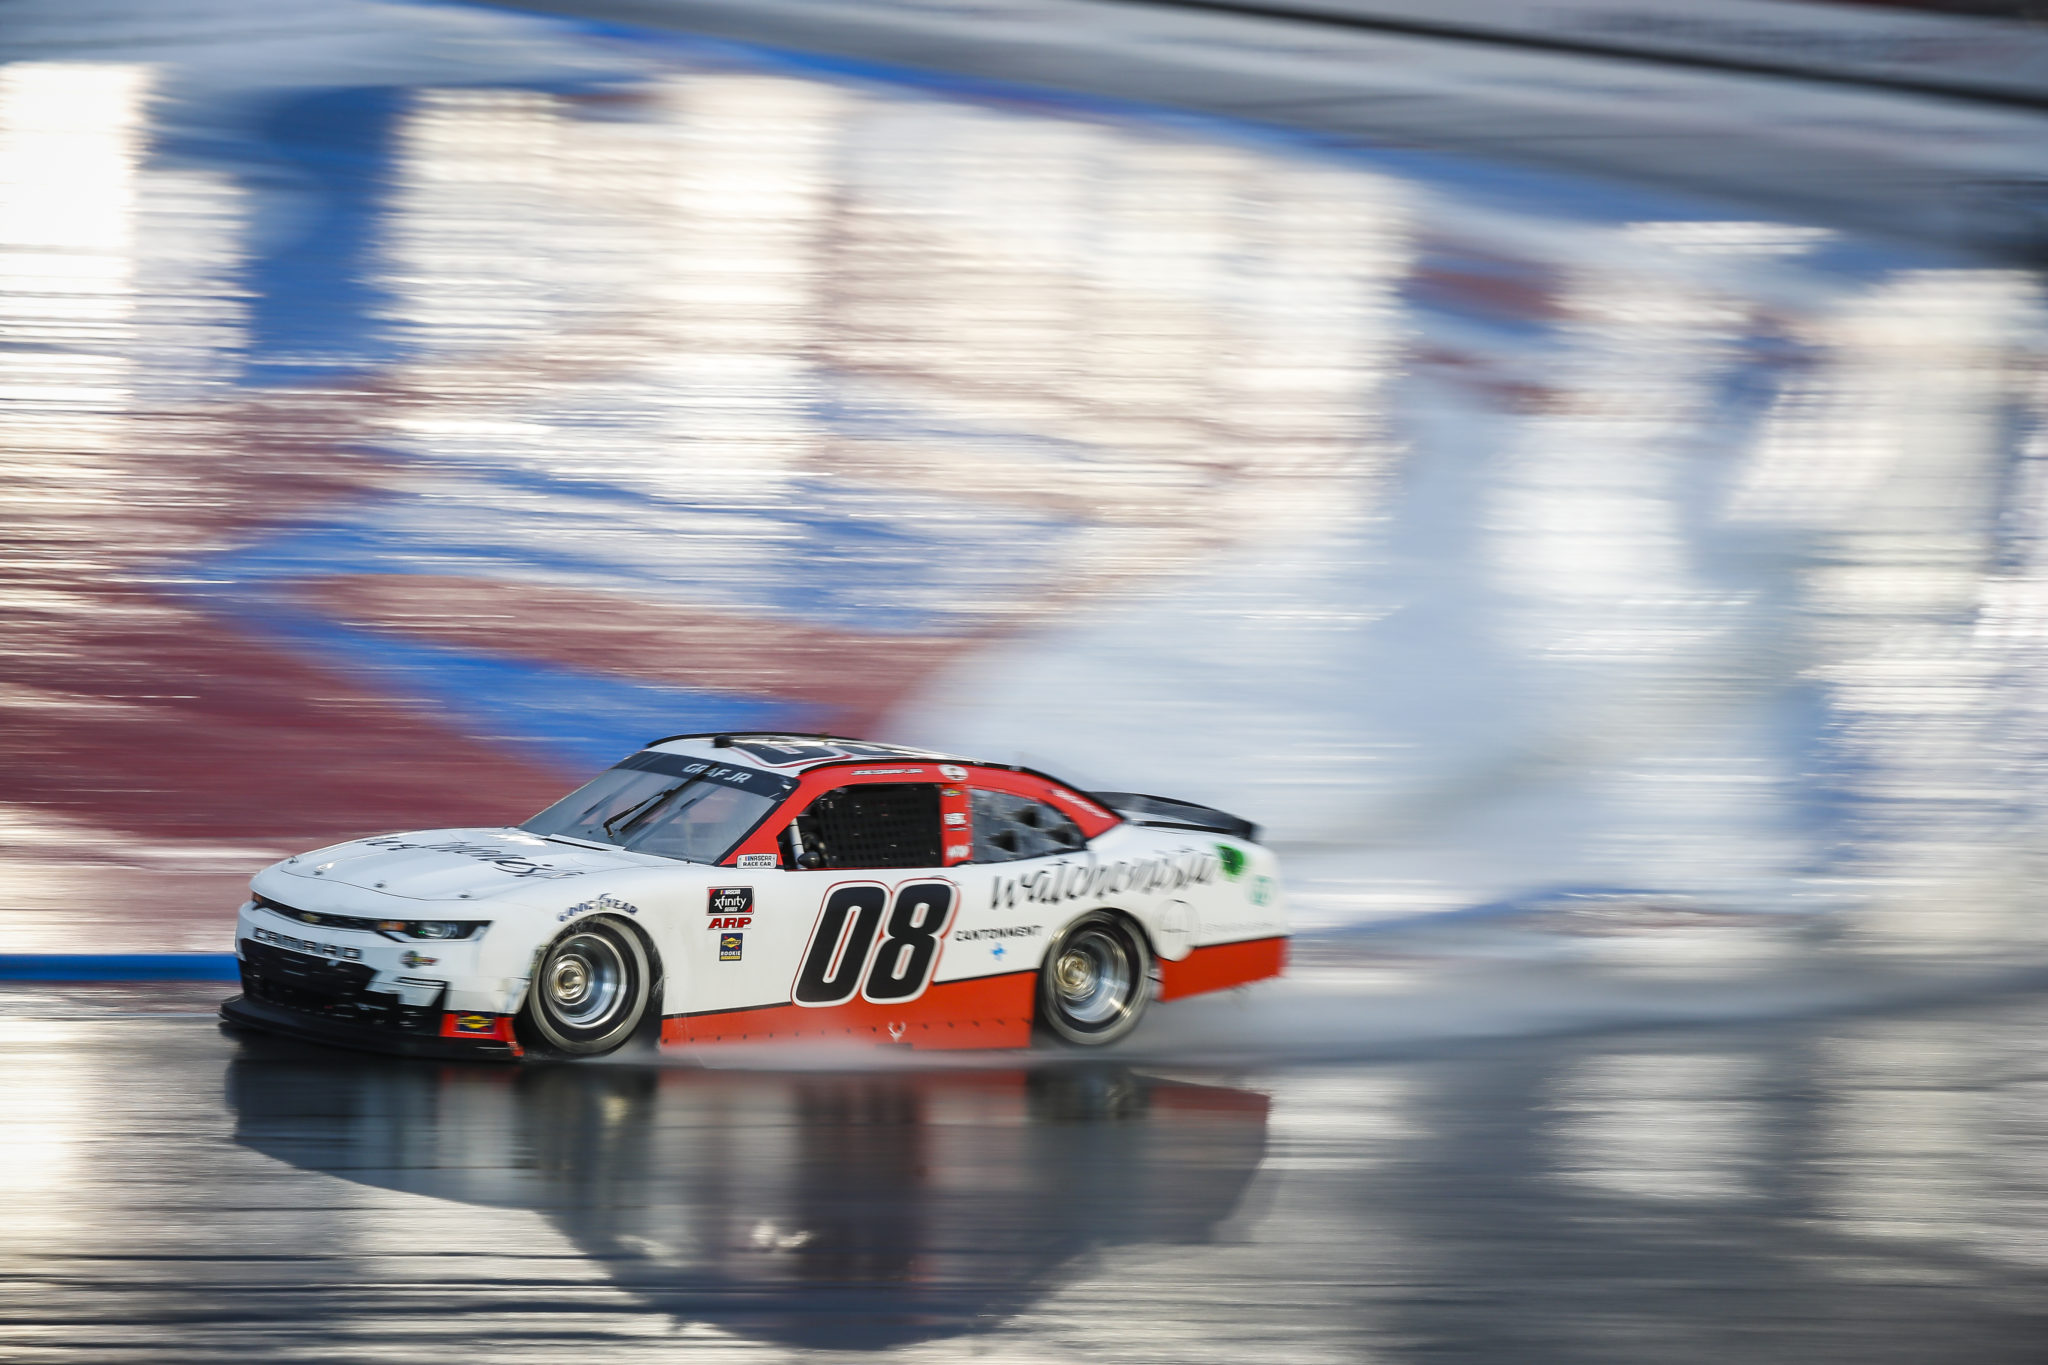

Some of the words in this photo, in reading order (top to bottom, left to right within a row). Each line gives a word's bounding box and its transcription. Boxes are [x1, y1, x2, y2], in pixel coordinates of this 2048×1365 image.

[682, 763, 732, 778] GRAF
[723, 771, 753, 784] JR
[714, 895, 747, 909] xfinity
[708, 917, 752, 928] ARP
[792, 880, 959, 1007] 08
